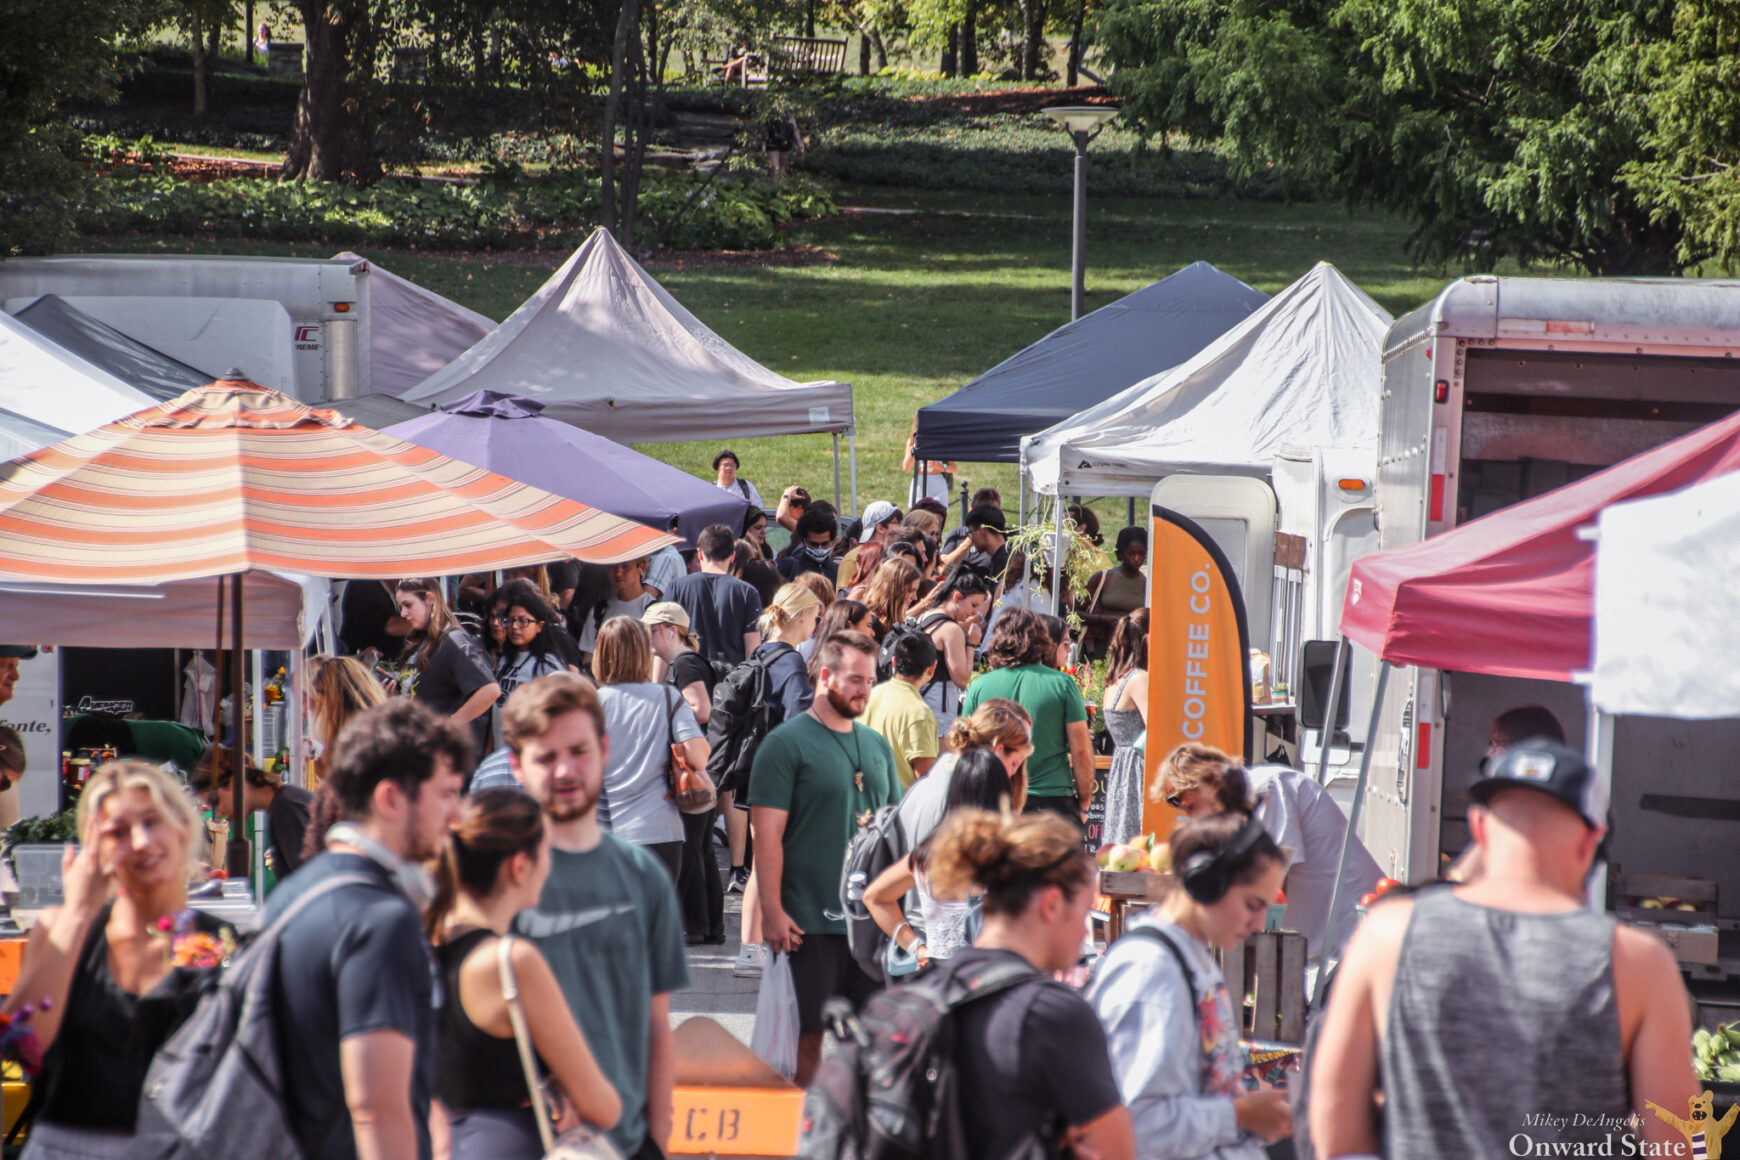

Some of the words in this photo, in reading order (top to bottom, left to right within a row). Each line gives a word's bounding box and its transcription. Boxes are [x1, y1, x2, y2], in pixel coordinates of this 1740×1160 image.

[1190, 563, 1211, 614] CO.
[1182, 623, 1210, 740] COFFEE
[673, 1107, 740, 1140] CB
